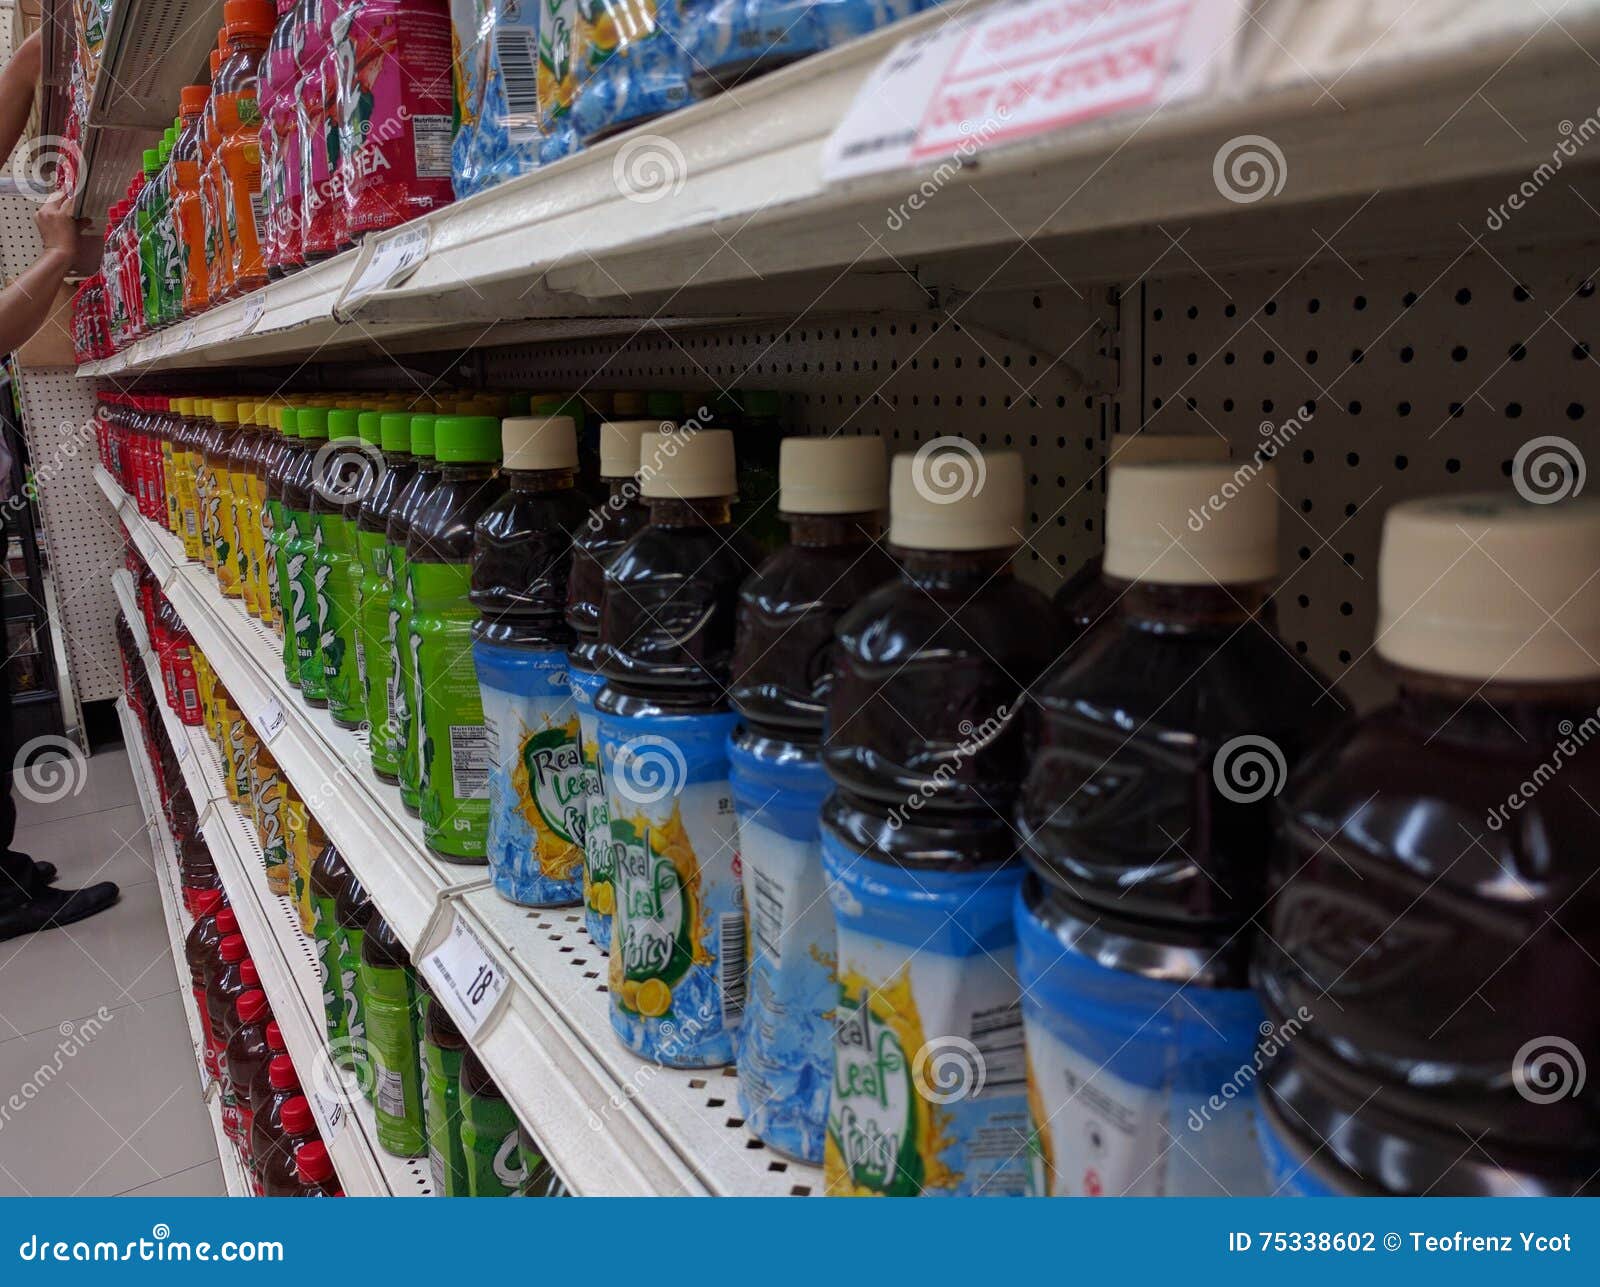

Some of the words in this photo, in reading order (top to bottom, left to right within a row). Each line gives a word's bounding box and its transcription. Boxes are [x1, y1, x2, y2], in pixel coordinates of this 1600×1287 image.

[533, 728, 585, 786] Real
[585, 752, 605, 796] eal
[259, 772, 285, 851] C2
[554, 774, 586, 806] Lea
[613, 826, 651, 883] Real
[625, 859, 676, 921] Leaf
[466, 963, 494, 1006] 18
[838, 988, 872, 1052] eal
[836, 1030, 902, 1110] Leaf
